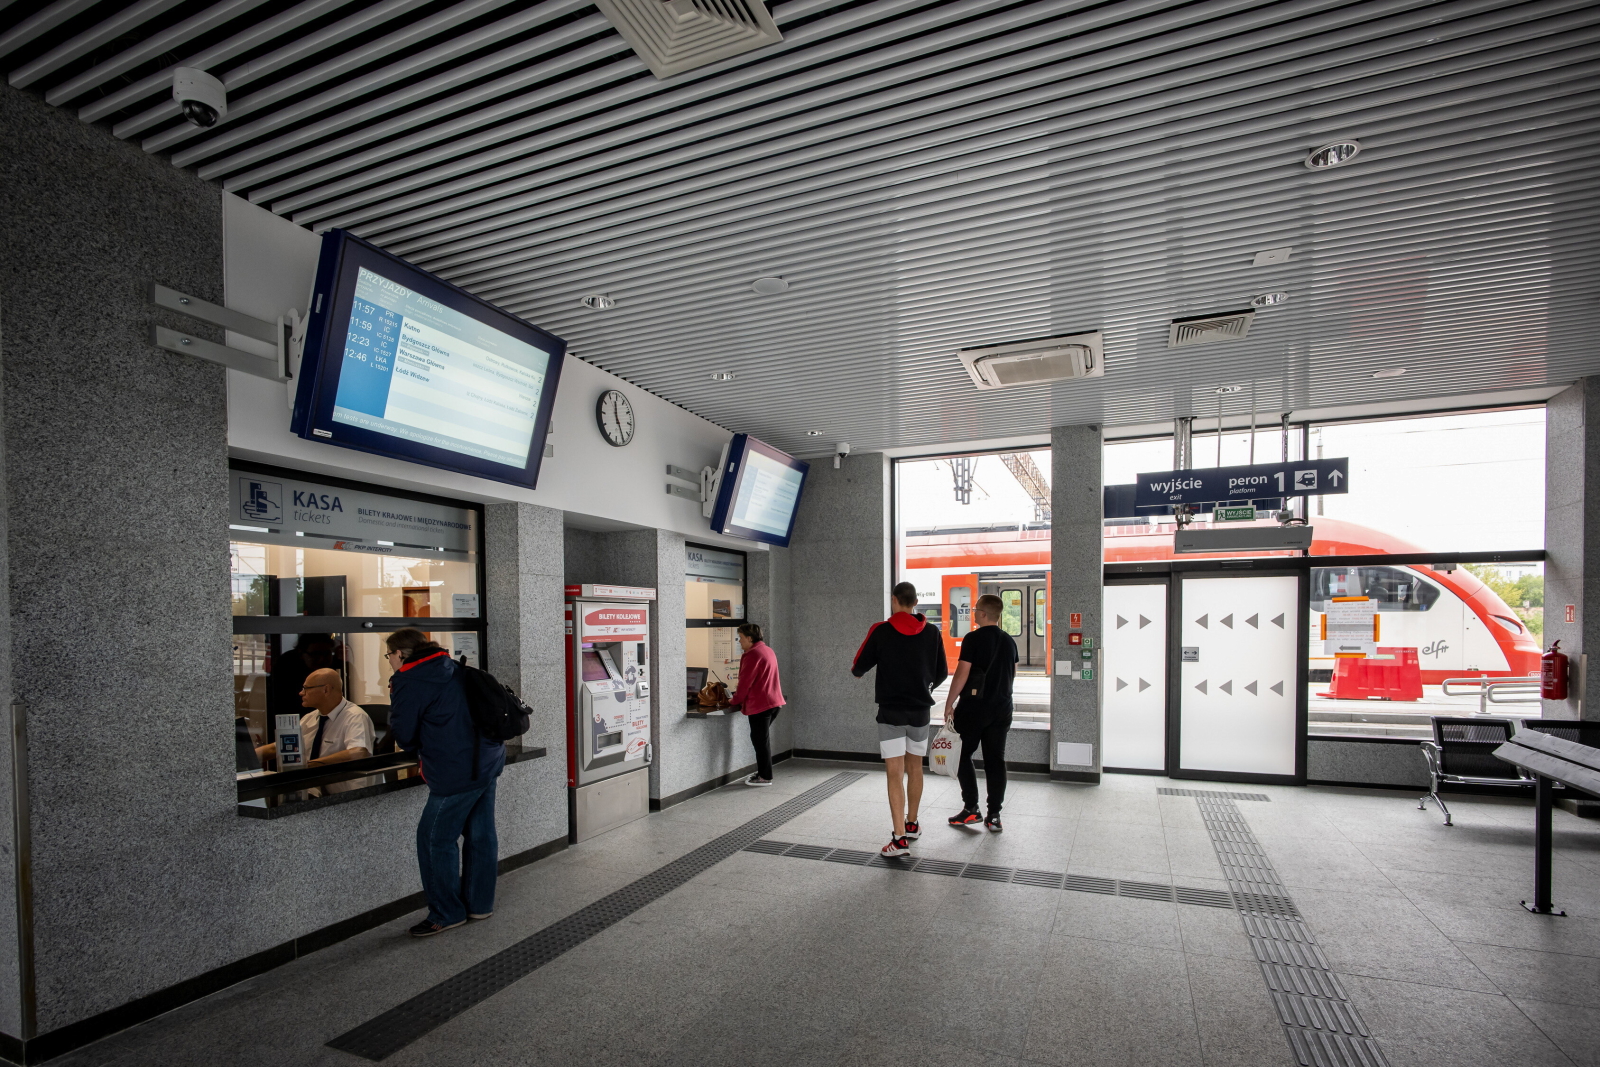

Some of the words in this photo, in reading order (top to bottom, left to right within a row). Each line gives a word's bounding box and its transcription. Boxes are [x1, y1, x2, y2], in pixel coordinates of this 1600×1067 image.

[360, 269, 412, 298] PRZYJAZDY
[417, 296, 443, 314] Arrivals
[353, 301, 375, 315] 11:57
[350, 316, 372, 331] 11:59
[347, 332, 370, 347] 12:23
[402, 333, 430, 350] Bydgoszcz
[431, 345, 450, 357] Główna
[344, 348, 367, 362] 12:46
[399, 348, 426, 362] Warszawa
[426, 358, 445, 370] Główna
[1150, 478, 1203, 494] wyjście
[1228, 475, 1268, 489] peron
[1273, 472, 1285, 493] 1
[1229, 487, 1256, 496] platform
[293, 490, 343, 512] KASA
[294, 509, 331, 524] tickets
[357, 508, 380, 517] BILETY
[382, 511, 413, 522] KRAJOWE
[417, 517, 472, 530] MIĘDZYNARODOWE
[358, 516, 385, 526] Domestic
[687, 552, 704, 562] KASA
[595, 714, 601, 722] 3
